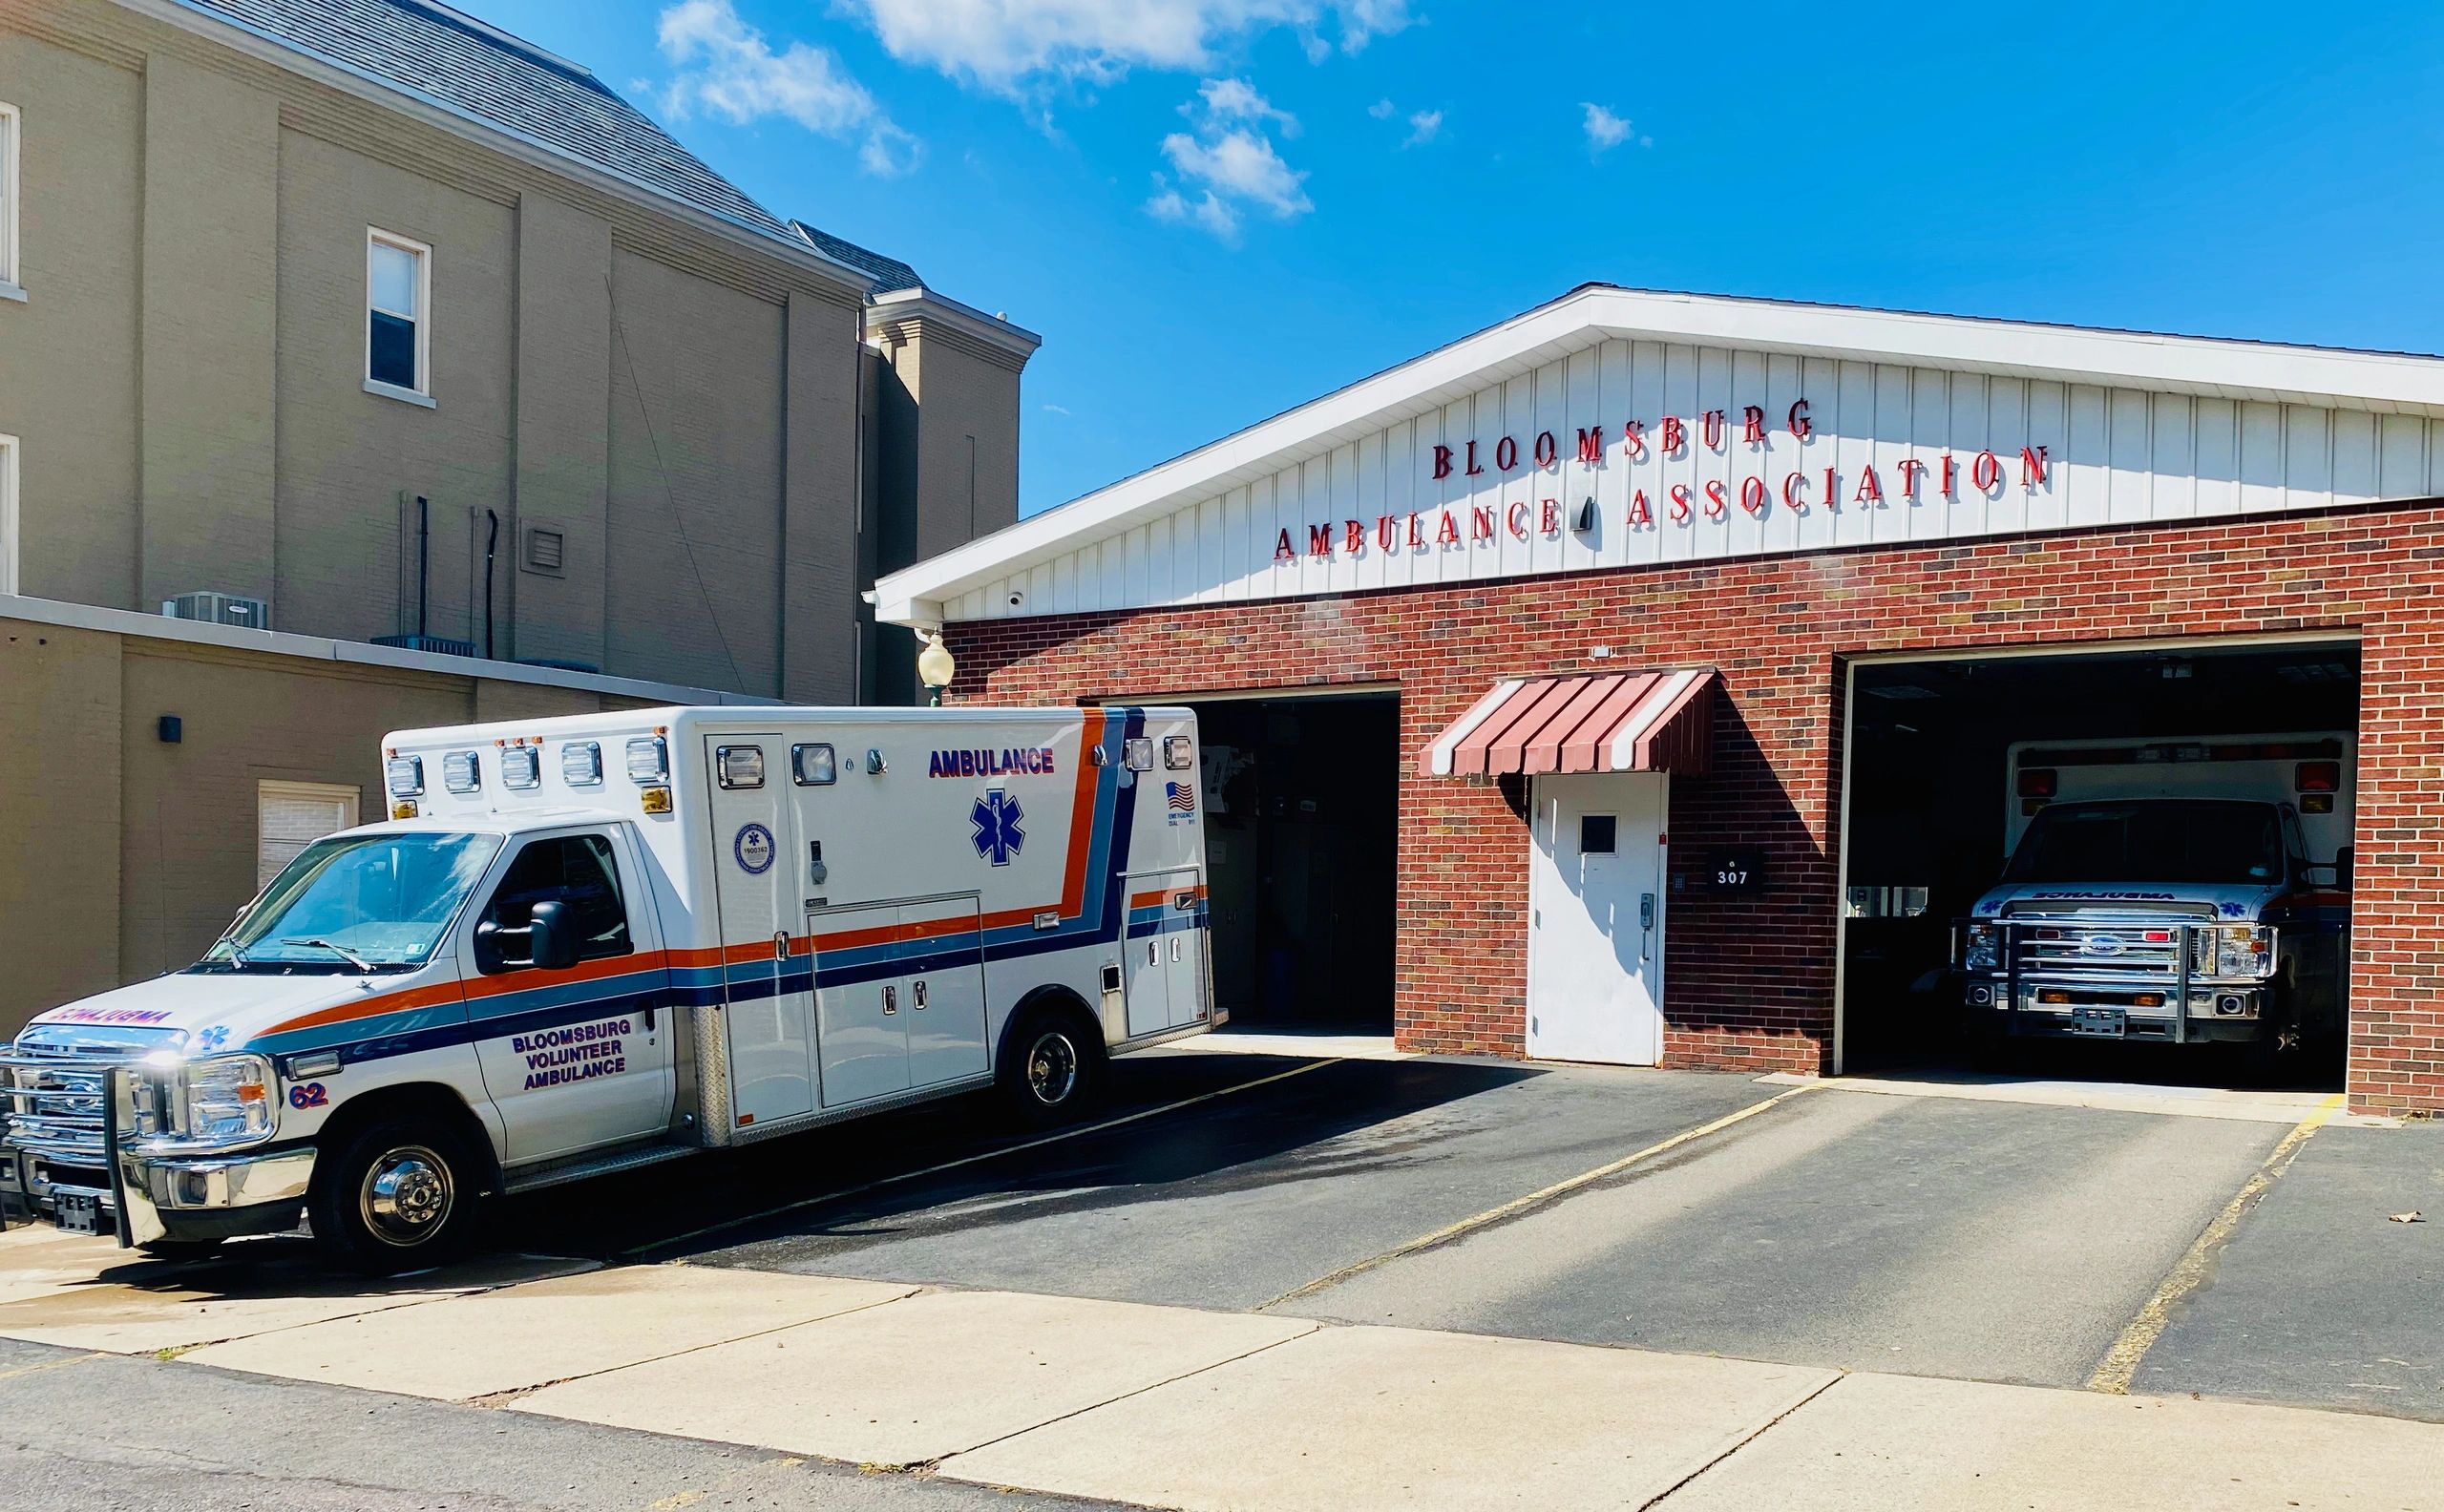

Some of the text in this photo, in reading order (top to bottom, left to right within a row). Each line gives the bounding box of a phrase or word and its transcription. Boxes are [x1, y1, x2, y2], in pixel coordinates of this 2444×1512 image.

[1432, 397, 1812, 480] BLOOMSBURG
[1273, 445, 2048, 560] AMBULANCE ASSOCIATION
[929, 747, 1054, 778] AMBULANCE
[1718, 871, 1747, 884] 307
[512, 1018, 631, 1054] BLOOMSBURG
[526, 1040, 622, 1070] VOLUNTEER
[524, 1057, 625, 1090] AMBULANCE
[289, 1082, 328, 1109] 62
